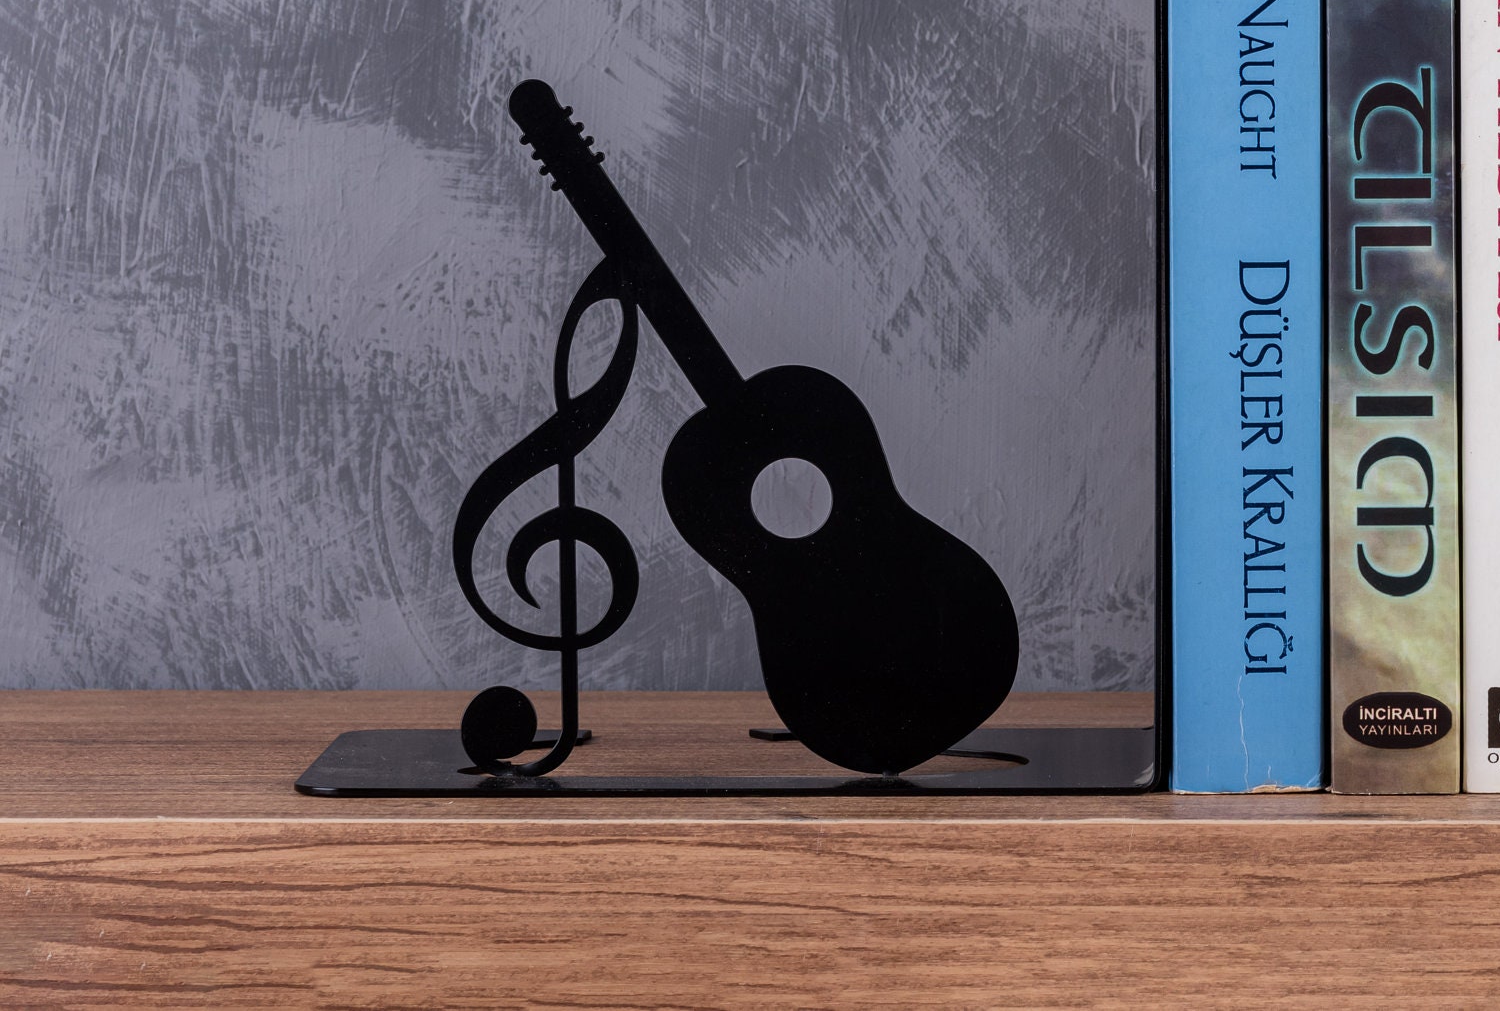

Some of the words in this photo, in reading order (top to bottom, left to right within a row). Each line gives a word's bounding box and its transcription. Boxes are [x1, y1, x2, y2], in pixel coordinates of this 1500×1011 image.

[1228, 259, 1291, 453] DÜŞLER
[1242, 465, 1293, 677] KRALLIĞI
[1358, 705, 1437, 721] İNCİRALTI
[1358, 722, 1438, 736] YAYINLARI
